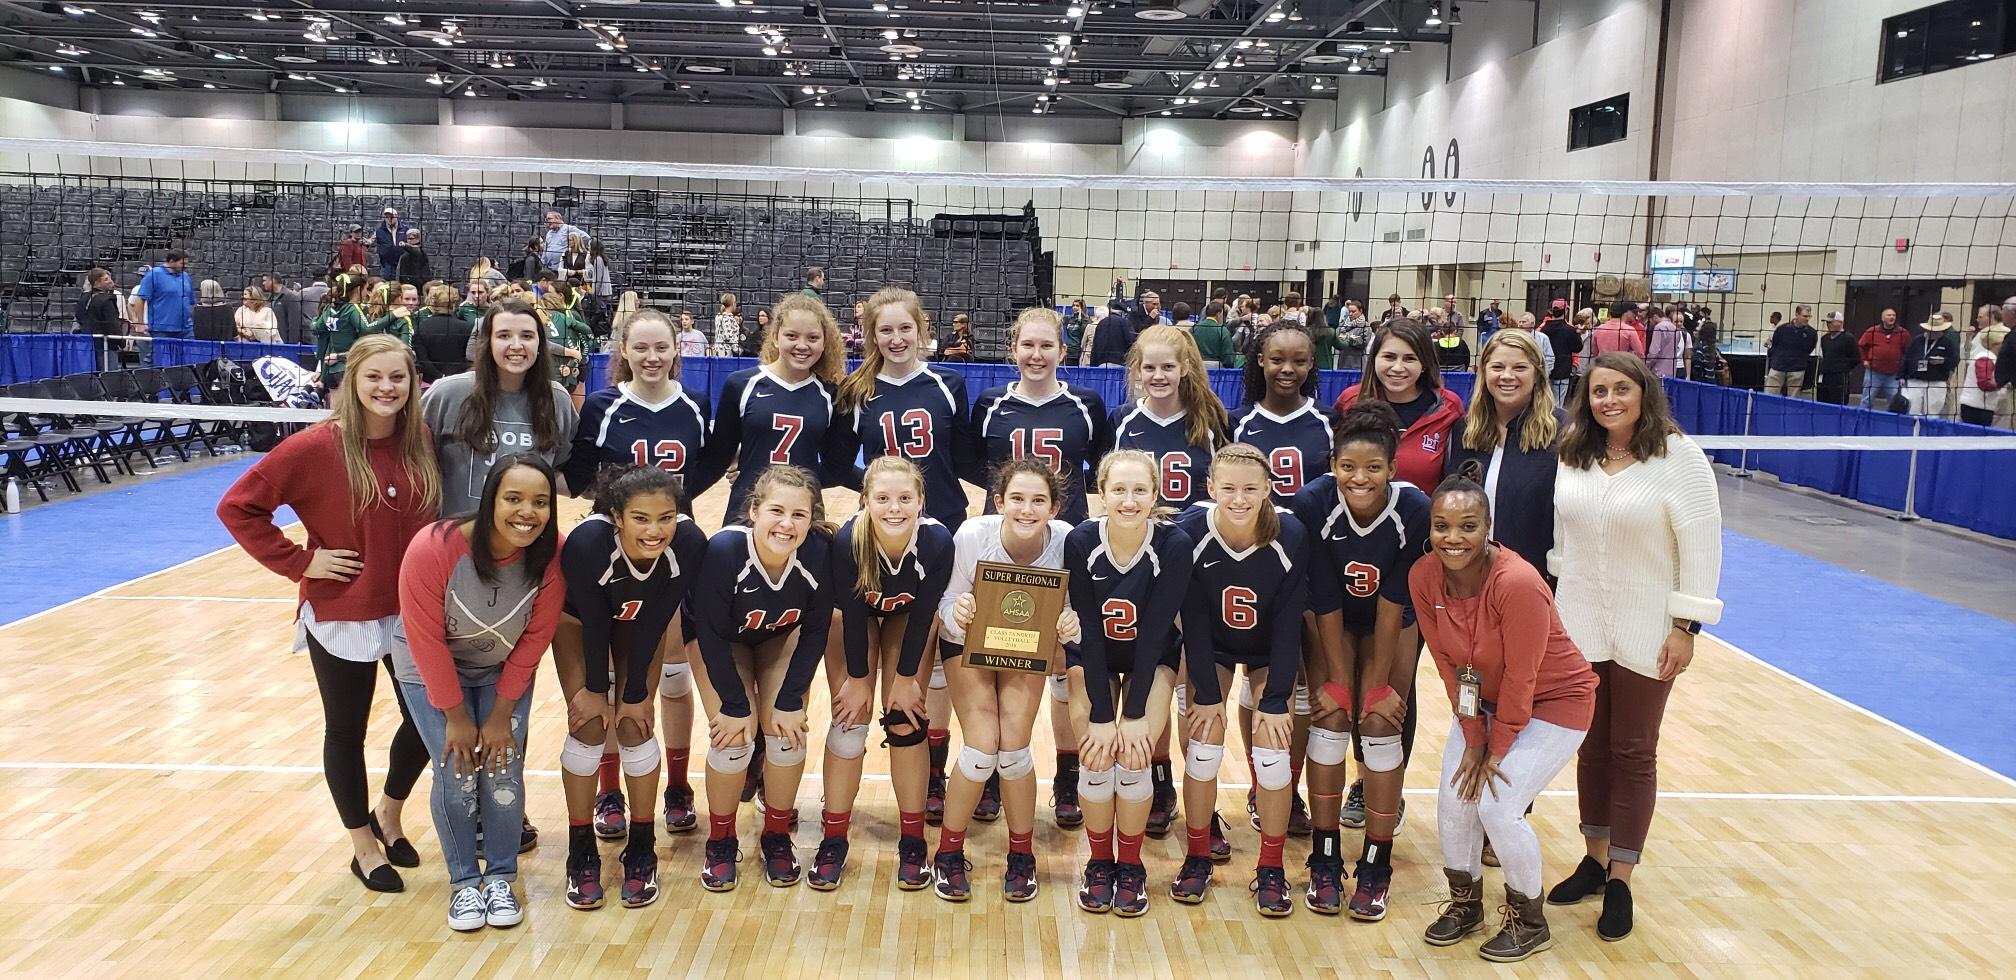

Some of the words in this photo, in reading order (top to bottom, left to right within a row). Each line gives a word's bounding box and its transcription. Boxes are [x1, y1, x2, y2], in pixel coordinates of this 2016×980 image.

[770, 413, 804, 464] 7
[879, 408, 934, 458] 13
[1010, 428, 1064, 474] 15
[631, 439, 686, 490] 12
[1269, 446, 1304, 496] 9
[985, 570, 1012, 581] SUPER
[1015, 573, 1059, 587] REGIONAL
[1344, 560, 1380, 597] 3
[613, 600, 643, 620] 1
[1003, 608, 1030, 617] AHSAA
[1102, 598, 1137, 641] 2
[1221, 585, 1257, 629] 6
[985, 655, 1032, 668] WINNER
